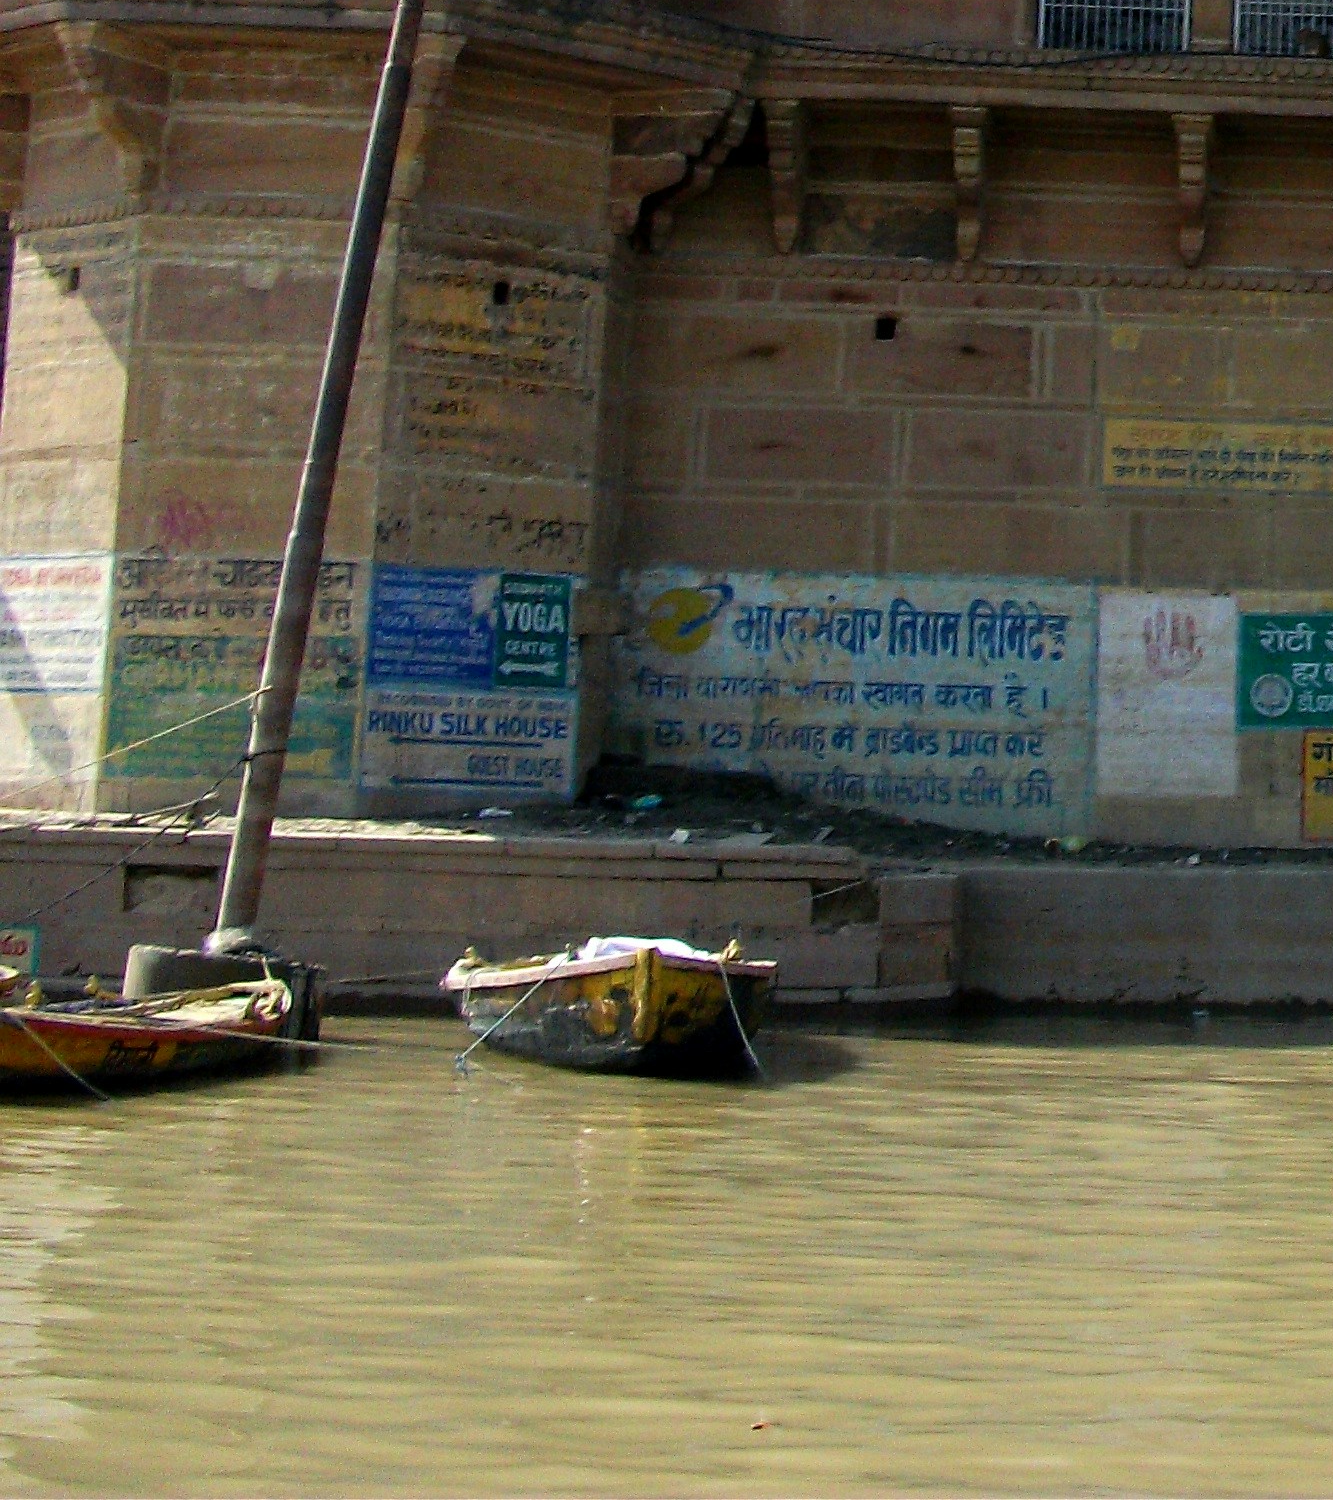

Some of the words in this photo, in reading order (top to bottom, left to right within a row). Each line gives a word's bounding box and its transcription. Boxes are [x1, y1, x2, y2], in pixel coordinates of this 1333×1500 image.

[502, 602, 564, 634] YOGA
[1259, 621, 1314, 655] रोटी
[439, 712, 489, 736] SILK
[494, 716, 569, 740] HOUSE
